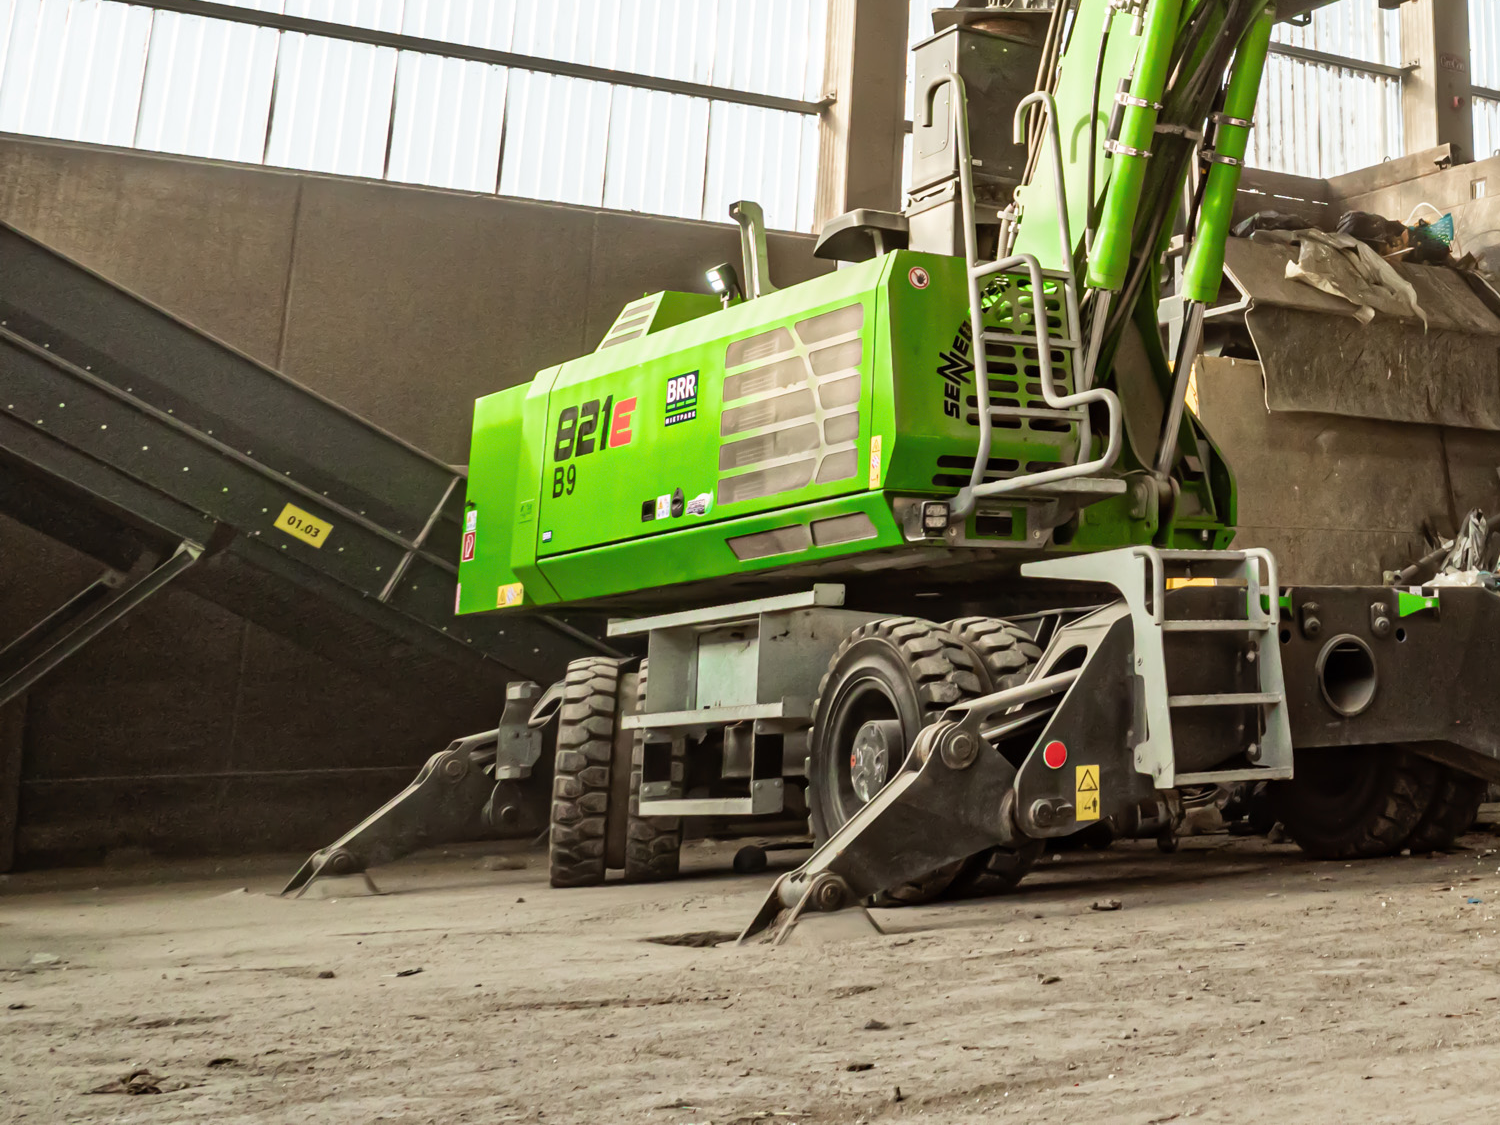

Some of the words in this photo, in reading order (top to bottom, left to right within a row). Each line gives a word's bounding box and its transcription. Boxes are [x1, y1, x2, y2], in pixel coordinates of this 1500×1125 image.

[666, 374, 696, 403] BRR
[553, 394, 637, 463] 821E
[665, 410, 696, 425] MIETPARK
[552, 464, 576, 499] B9
[287, 515, 320, 537] 01.03
